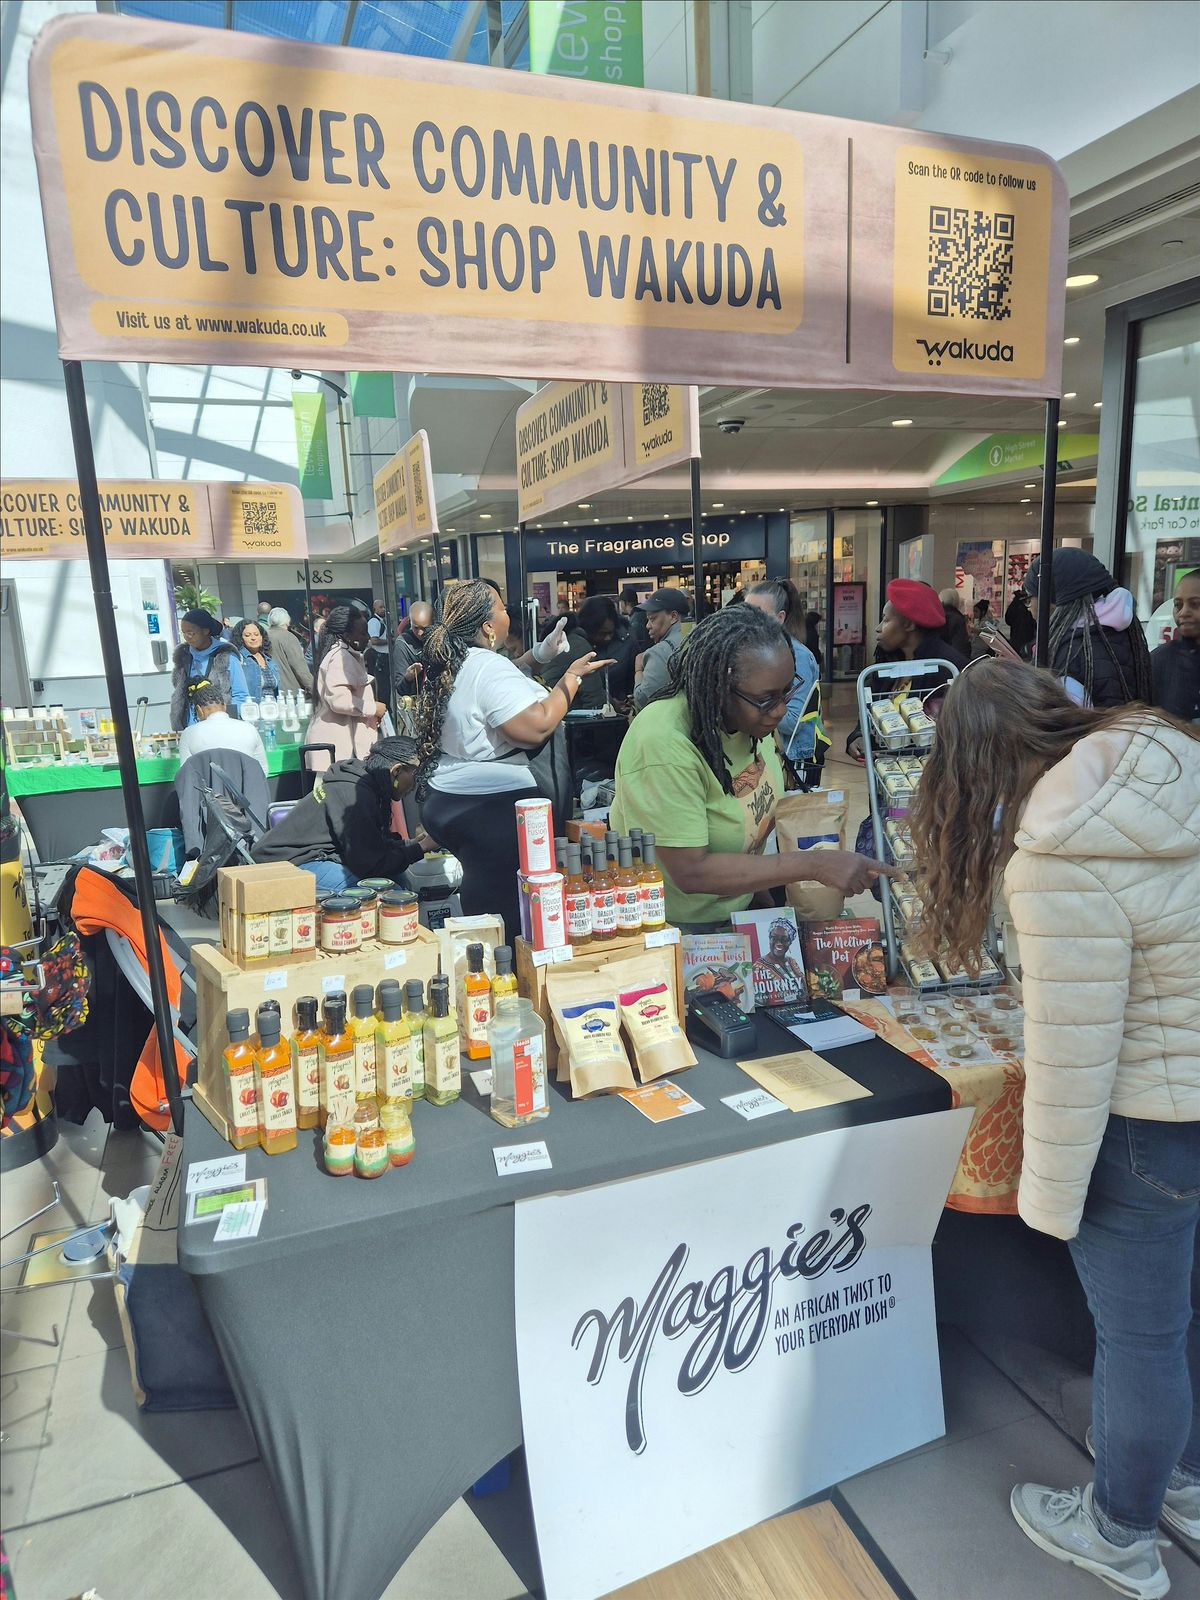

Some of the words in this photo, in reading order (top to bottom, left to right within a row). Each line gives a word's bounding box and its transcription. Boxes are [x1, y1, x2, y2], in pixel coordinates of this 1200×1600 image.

[78, 80, 390, 190] DISCOVER
[412, 120, 737, 222] COMMUNITY
[757, 163, 787, 227] &
[908, 161, 930, 176] Scan
[933, 164, 947, 179] the
[950, 167, 960, 181] QR
[964, 170, 984, 183] code
[986, 172, 996, 185] to
[999, 174, 1024, 189] follow
[1026, 179, 1036, 190] us
[104, 188, 397, 282] CULTURE:
[417, 216, 556, 294] SHOP
[578, 230, 782, 311] WAKUDA
[116, 311, 149, 329] Visit
[154, 316, 170, 329] us
[175, 314, 192, 330] at
[196, 317, 326, 337] www.wakuda.co.uk
[916, 338, 1013, 366] wakuda
[519, 412, 548, 456] DISCOVER
[549, 382, 597, 436] COMMUNITY
[551, 437, 570, 474] SHOP
[572, 415, 609, 463] WAKUDA
[642, 429, 672, 457] wakuda
[0, 493, 60, 512] COVER
[178, 494, 190, 513] &
[69, 517, 112, 536] SP
[120, 517, 191, 536] WAKUDA
[242, 540, 281, 549] wakuda
[547, 541, 579, 555] The
[585, 536, 675, 554] Fragrance
[296, 569, 333, 584] M&S
[627, 566, 649, 574] DIOR
[813, 937, 833, 950] The
[834, 935, 873, 950] Melting
[684, 951, 720, 966] African
[721, 950, 746, 962] Twist
[832, 950, 850, 964] Pot
[753, 977, 802, 995] JOURNEY
[754, 970, 771, 980] THE
[154, 1168, 169, 1194] ALARM
[162, 1137, 179, 1167] FREE
[774, 1307, 789, 1330] AN
[794, 1290, 839, 1323] AFRICAN
[843, 1278, 874, 1306] TWIST
[877, 1273, 892, 1295] TO
[571, 1203, 873, 1455] Maggie's
[775, 1328, 805, 1355] YOUR
[808, 1308, 861, 1344] EVERYDAY
